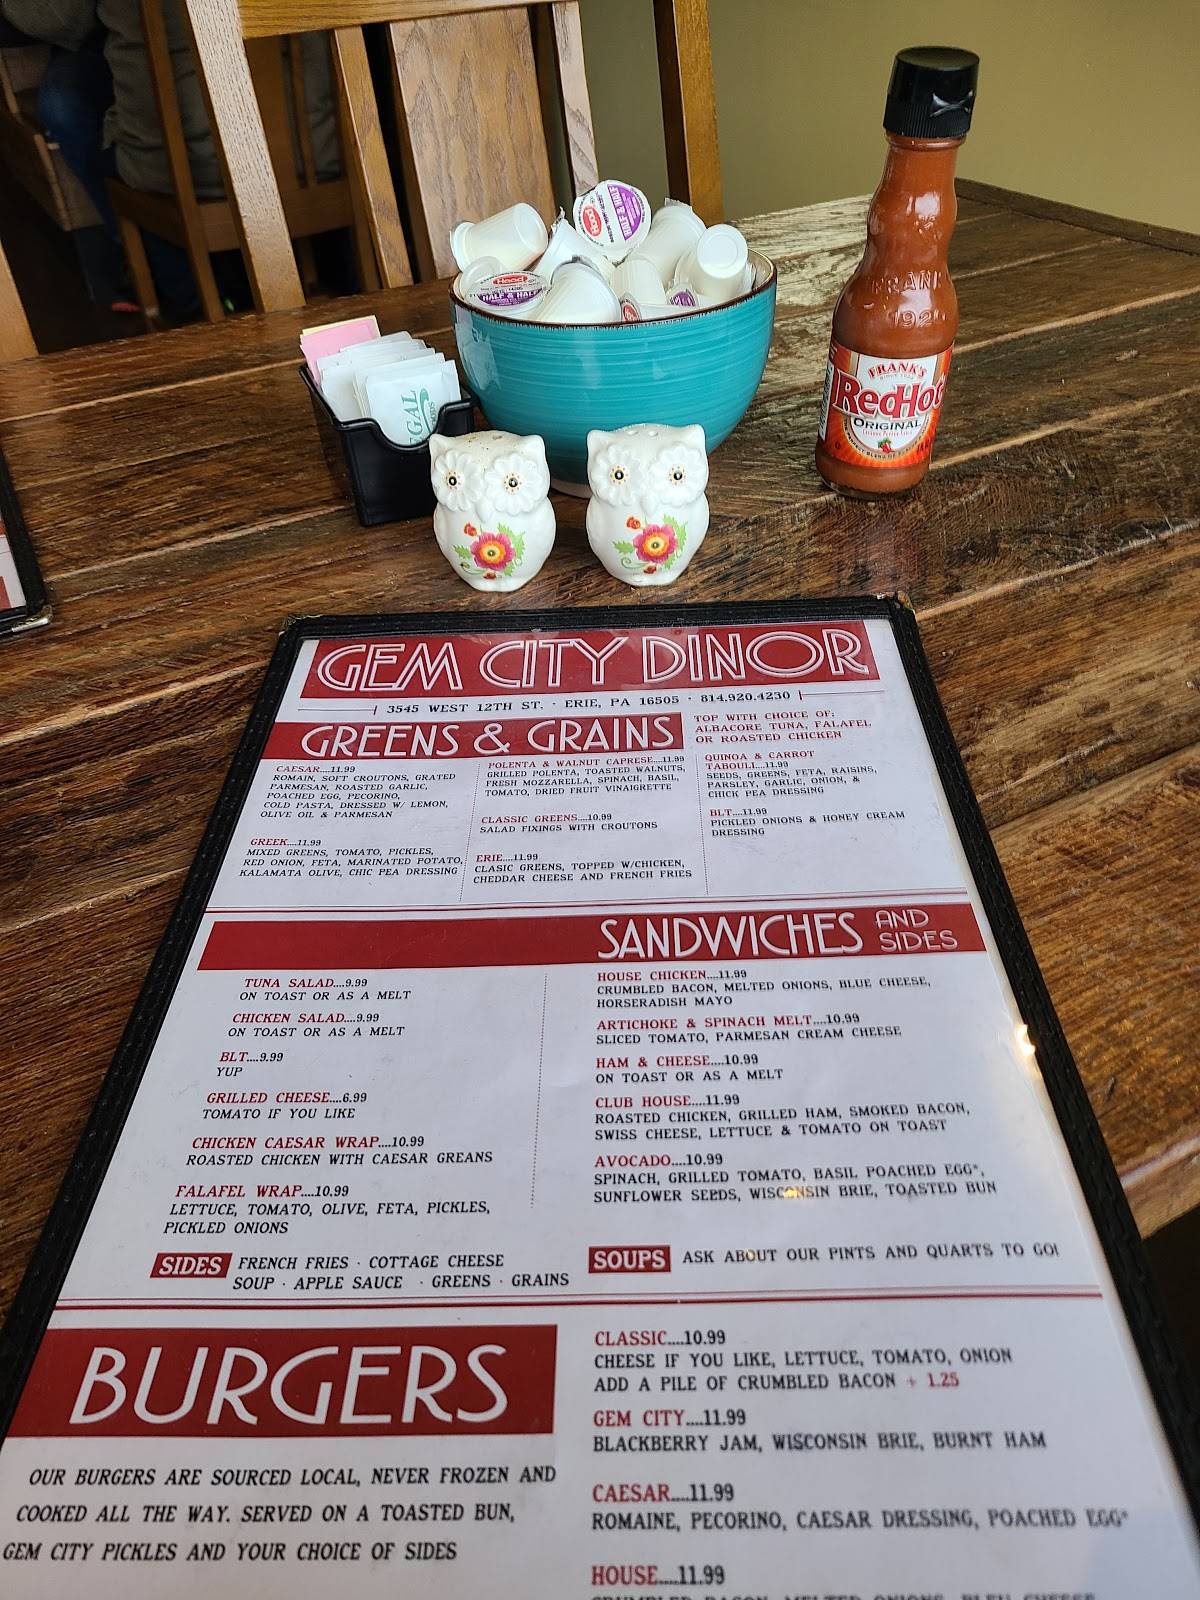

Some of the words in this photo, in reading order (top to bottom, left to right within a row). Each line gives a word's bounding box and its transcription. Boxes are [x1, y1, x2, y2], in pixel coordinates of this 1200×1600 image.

[854, 418, 921, 430] ORIGINAL
[316, 642, 464, 692] GEM
[479, 636, 630, 689] CITY
[641, 628, 870, 685] DINOR
[386, 704, 419, 714] 3545
[428, 703, 469, 713] WEST
[476, 702, 513, 712] 12TH
[521, 701, 543, 710] ST.
[565, 698, 598, 708] ERIE,
[610, 698, 630, 707] PA
[639, 695, 680, 706] 16505
[700, 691, 791, 703] 814.920.4230
[693, 714, 719, 723] TOP
[725, 713, 757, 721] WITH
[764, 711, 809, 720] CHOICE
[301, 724, 460, 757] GREENS
[473, 722, 511, 755] &
[527, 716, 674, 753] GRAINS
[704, 753, 748, 762] QUINOA
[768, 750, 815, 759] CARROT
[272, 774, 316, 783] ROMAIN,
[353, 774, 409, 782] CROUTONS,
[415, 773, 456, 781] GRATED
[266, 792, 315, 800] POACHED
[320, 793, 342, 801] EGG,
[347, 792, 400, 800] PECORINO,
[484, 788, 530, 797] TOMATO,
[535, 787, 565, 795] DRIED
[570, 785, 600, 794] FRUIT
[605, 783, 672, 792] VINAIGRETTE
[479, 825, 516, 834] SALAD
[521, 824, 563, 833] FIXINGS
[568, 823, 595, 831] WITH
[601, 821, 658, 831] CROUTONS
[246, 848, 281, 856] MIXED
[286, 848, 329, 858] GREENS,
[335, 848, 382, 857] TOMATO,
[388, 847, 434, 856] PICKLES,
[875, 909, 929, 929] AND
[597, 911, 864, 959] SANDWICHES
[879, 929, 958, 951] SIDES
[244, 978, 280, 988] TUNA
[597, 971, 642, 982] HOUSE
[597, 984, 665, 995] CRUMBLED
[671, 983, 717, 994] BACON,
[724, 981, 775, 992] MELTED
[781, 980, 833, 990] ONIONS,
[839, 978, 872, 989] BLUE
[878, 977, 931, 987] CHEESE,
[239, 991, 258, 1001] ON
[264, 991, 307, 1001] TOAST
[312, 991, 330, 1001] OR
[336, 991, 354, 1001] AS
[360, 991, 370, 1000] A
[376, 990, 412, 1000] MELT
[596, 997, 687, 1008] HORSERADISH
[694, 995, 733, 1006] MAYO
[596, 1034, 641, 1045] SLICED
[648, 1033, 709, 1044] TOMATO,
[716, 1030, 790, 1042] PARMESAN
[797, 1028, 844, 1039] CREAM
[851, 1026, 902, 1037] CHEESE
[217, 1066, 243, 1077] YUP
[202, 1108, 261, 1120] TOMATO
[267, 1108, 282, 1119] IF
[289, 1108, 318, 1119] YOU
[324, 1108, 356, 1119] LIKE
[595, 1129, 637, 1140] SWISS
[645, 1127, 702, 1140] CHEESE,
[709, 1126, 772, 1138] LETTUCE
[781, 1125, 791, 1136] &
[798, 1122, 862, 1135] TOMATO
[869, 1121, 889, 1132] ON
[899, 1119, 945, 1132] TOAST
[185, 1154, 254, 1166] ROASTED
[260, 1154, 321, 1166] CHICKEN
[329, 1153, 365, 1165] WITH
[372, 1152, 428, 1165] CAESAR
[436, 1151, 493, 1164] GREANS
[169, 1203, 238, 1217] LETTUCE,
[247, 1203, 313, 1217] TOMATO,
[321, 1202, 368, 1217] OLIVE,
[377, 1202, 418, 1216] FETA,
[427, 1201, 490, 1215] PICKLES,
[593, 1249, 666, 1270] SOUPS
[682, 1250, 715, 1264] ASK
[724, 1249, 777, 1263] ABOUT
[786, 1248, 820, 1261] OUR
[828, 1247, 876, 1260] PINTS
[885, 1245, 918, 1259] AND
[926, 1244, 994, 1259] QUARTS
[1001, 1243, 1025, 1256] TO
[1032, 1243, 1059, 1256] GO!
[158, 1256, 223, 1276] SIDES
[238, 1256, 298, 1270] FRENCH
[305, 1256, 349, 1270] FRIES
[369, 1255, 439, 1269] COTTAGE
[447, 1254, 504, 1268] CHEESE
[232, 1276, 275, 1290] SOUP
[293, 1276, 344, 1290] APPLE
[352, 1275, 403, 1290] SAUCE
[431, 1274, 491, 1289] GREENS
[511, 1273, 569, 1287] GRAINS
[594, 1353, 656, 1369] CHEESE
[665, 1353, 679, 1368] IF
[690, 1352, 724, 1368] YOU
[733, 1352, 776, 1368] LIKE,
[784, 1350, 864, 1367] LETTUCE,
[872, 1349, 952, 1366] TOMATO,
[959, 1348, 1012, 1363] ONION
[69, 1344, 508, 1425] BURGERS
[29, 1468, 67, 1486] OUR
[74, 1468, 156, 1486] BURGERS
[164, 1468, 203, 1486] ARE
[210, 1469, 292, 1486] SOURCED
[300, 1468, 360, 1487] LOCAL,
[371, 1467, 430, 1485] NEVER
[439, 1466, 509, 1484] FROZEN
[519, 1465, 556, 1483] AND
[3, 1543, 42, 1560] GEM
[50, 1542, 94, 1561] CITY
[101, 1542, 178, 1561] PICKLES
[186, 1543, 226, 1562] AND
[238, 1543, 286, 1561] YOUR
[296, 1542, 362, 1561] CHOICE
[371, 1542, 396, 1561] OF
[404, 1541, 457, 1561] SIDES
